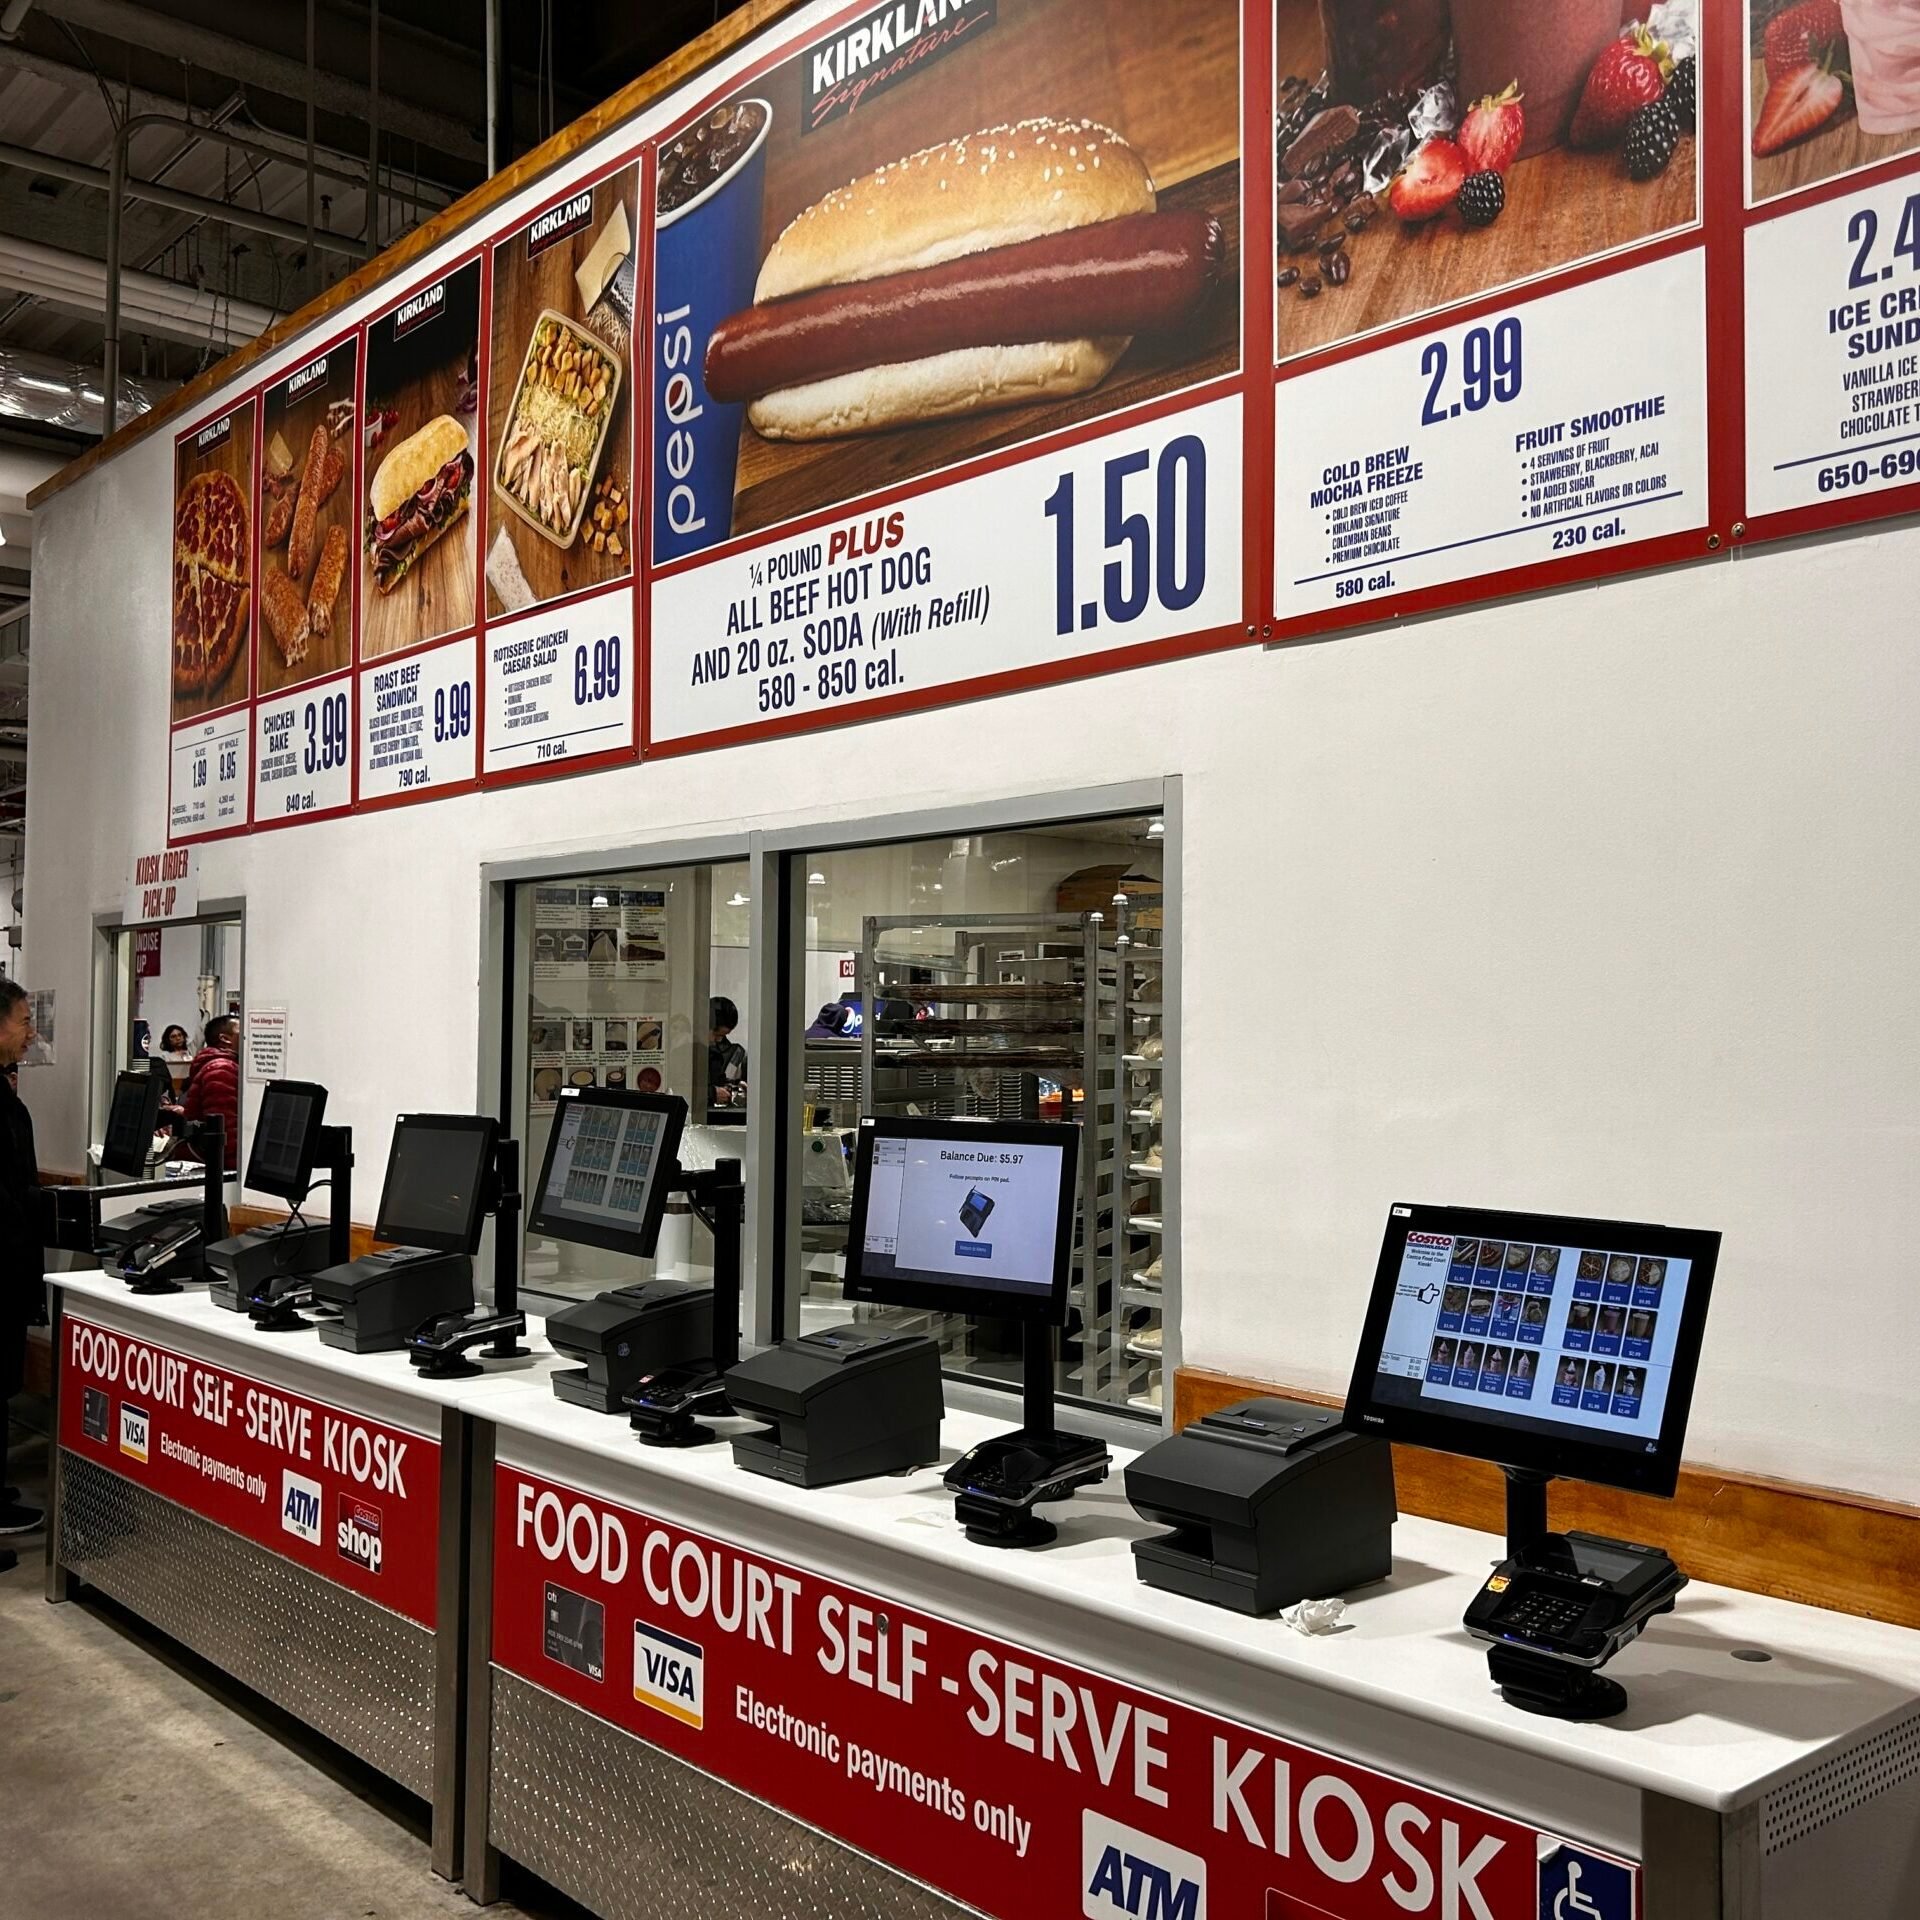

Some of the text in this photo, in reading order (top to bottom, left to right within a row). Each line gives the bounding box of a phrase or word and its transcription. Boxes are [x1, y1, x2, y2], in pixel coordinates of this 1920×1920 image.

[813, 0, 973, 95] KIRKLA
[812, 11, 989, 128] Signature
[531, 195, 591, 244] KIRKLAND
[397, 284, 443, 326] KIRKLAND
[1829, 286, 1920, 334] ICE CR
[289, 359, 326, 393] KIRKLAND
[1421, 316, 1522, 427] 2.99
[1843, 355, 1918, 391] VANILLA ICE
[1852, 379, 1920, 413] STRAWBER
[199, 417, 230, 447] KIRKLAND
[657, 304, 706, 534] pepsi
[1515, 395, 1665, 453] FRUIT SMOOTHIE
[1840, 406, 1910, 439] CHOCOLATE
[1323, 445, 1410, 485] COLD BREW
[1530, 437, 1610, 470] 4 SERVINGS OF FRUIT
[1530, 442, 1659, 486] STRAWBERRY, BLACKBERRY, ACAI
[1818, 446, 1920, 493] 650-69
[1310, 462, 1423, 509] MOCHA FREEZE
[1530, 475, 1595, 503] NO ADDED SUGAR
[1530, 474, 1667, 519] NO ARTIFICIAL FLAVORS OR COLORS
[1332, 507, 1348, 521] COLD
[1369, 497, 1384, 513] ICED
[1385, 490, 1408, 507] COFFEE
[1332, 508, 1400, 536] KIRKLAND SIGNATURE
[768, 543, 822, 584] POUND
[827, 511, 905, 566] PLUS
[1044, 434, 1206, 636] 1.50
[1332, 524, 1392, 550] COLOMBIAN BEANS
[1332, 537, 1400, 564] PREMIUM CHOCOLATE
[1552, 518, 1625, 550] 230 cal.
[726, 547, 931, 636] ALL BEEF HOT DOG
[1336, 571, 1395, 599] 580 cal.
[493, 629, 569, 663] ROTISSERIE CHICKEN
[691, 584, 990, 686] AND 20 oz. SODA (With Refill)
[374, 663, 420, 693] ROAST BEEF
[502, 648, 557, 675] CAESAR SALAD
[574, 635, 621, 706] 6.99
[377, 685, 417, 712] SANDWICH
[758, 672, 795, 712] 580
[817, 658, 857, 700] 850
[865, 649, 904, 690] cal.
[263, 709, 295, 735] CHICKEN
[434, 681, 470, 742] 9.99
[269, 732, 289, 753] BAKE
[304, 692, 347, 774] 3.99
[537, 740, 567, 759] 710 cal.
[193, 759, 207, 788] 1.99
[219, 751, 236, 781] 9.95
[398, 765, 431, 787] 790 cal.
[286, 790, 317, 813] 840 cal.
[136, 849, 189, 886] KIOSK ORDER
[142, 886, 176, 919] PICK-UP
[940, 1150, 1023, 1165] Balance Due: $5.97
[1407, 1232, 1452, 1245] COSTCO
[72, 1324, 120, 1382] FOOD
[124, 1343, 188, 1409] COURT
[323, 1416, 407, 1499] KIOSK
[1363, 1414, 1385, 1424] TOSHIBA
[124, 1418, 145, 1447] VISA
[160, 1432, 267, 1504] Electronic payments only
[284, 1487, 319, 1530] ATM
[338, 1518, 382, 1573] shop
[588, 1663, 602, 1679] VISA
[641, 1646, 695, 1703] VISA
[517, 1481, 628, 1585] FOOD
[642, 1529, 801, 1657] COURT
[1212, 1735, 1507, 1920] KIOSK
[736, 1684, 1032, 1858] Electronic payments only
[1088, 1844, 1200, 1920] ATM
